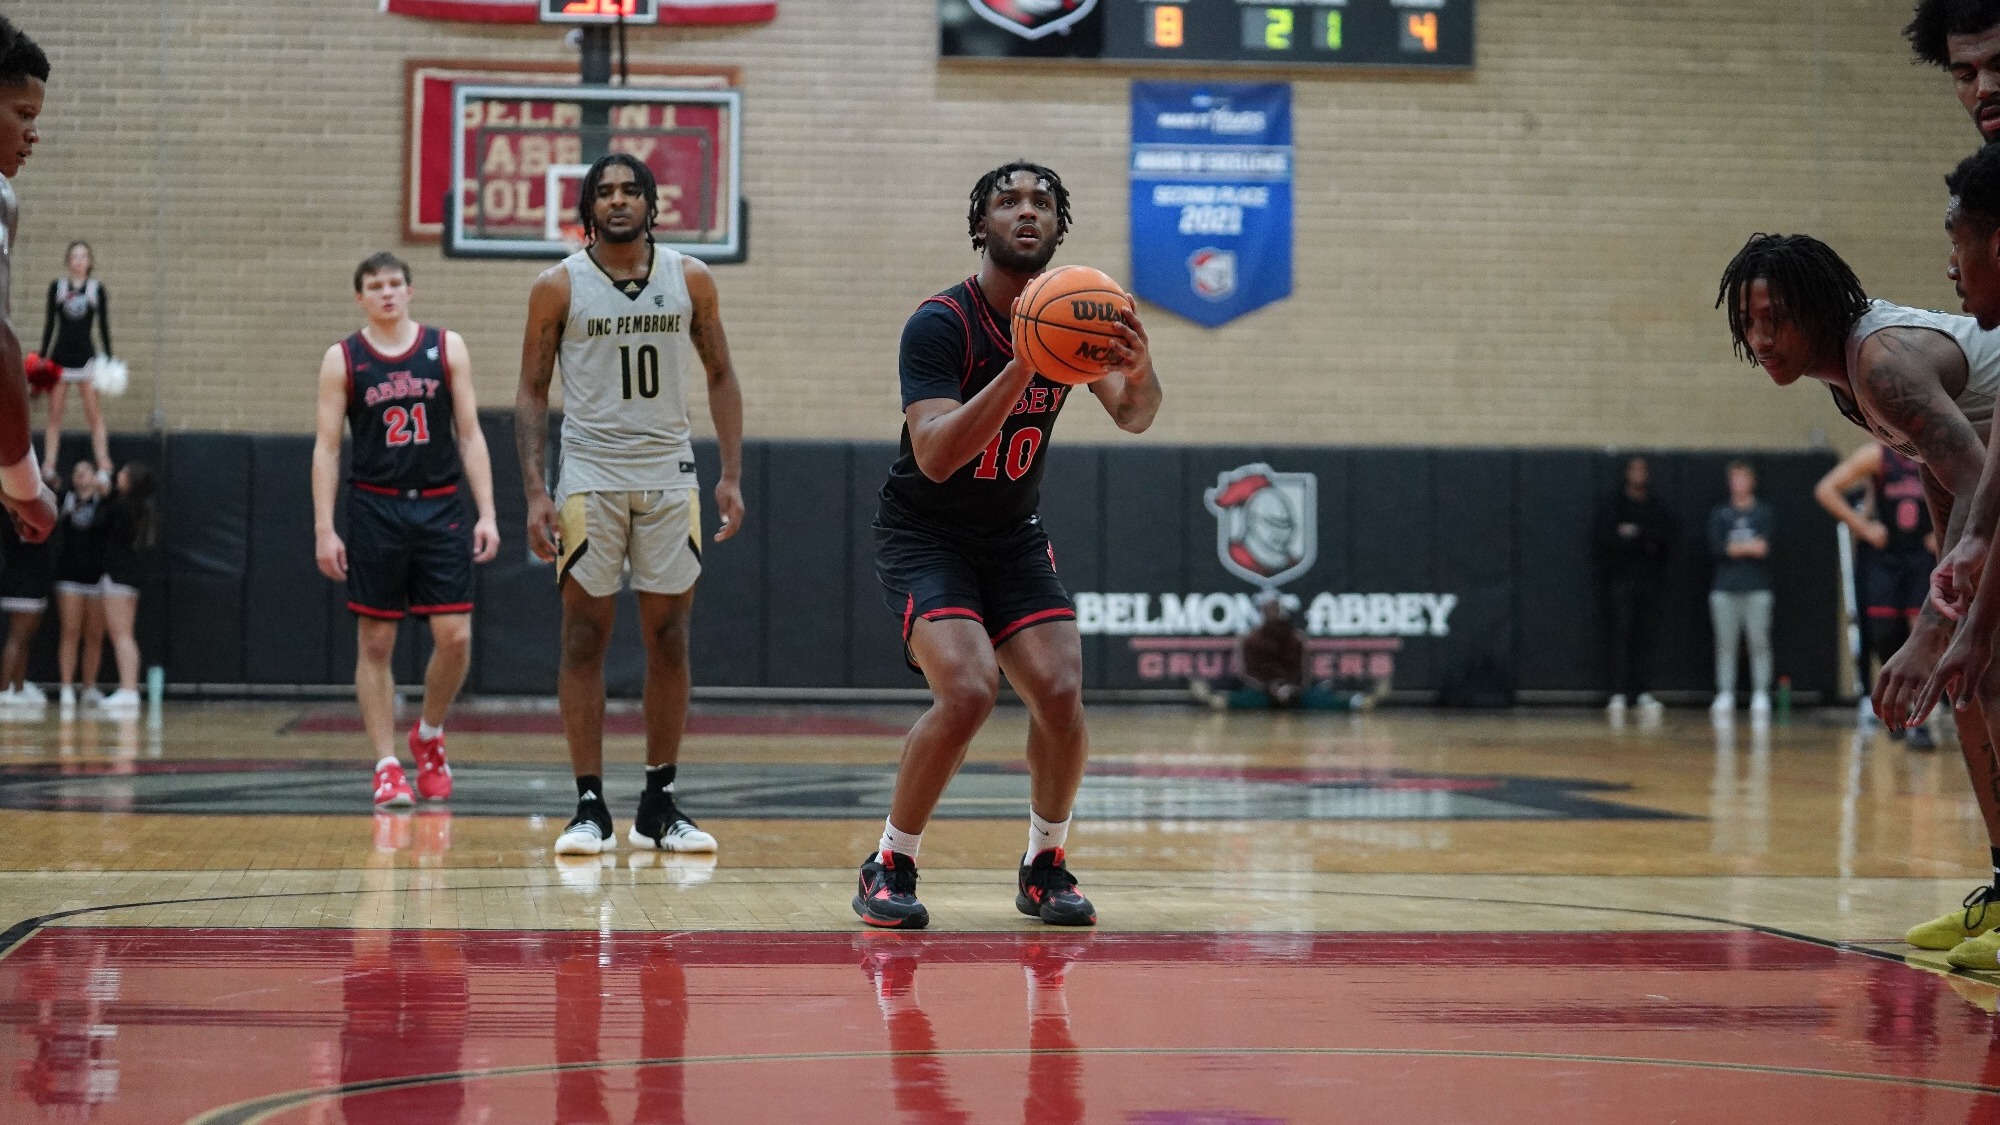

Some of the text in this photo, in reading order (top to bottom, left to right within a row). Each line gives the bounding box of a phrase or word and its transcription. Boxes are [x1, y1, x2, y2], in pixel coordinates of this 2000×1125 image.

[1154, 6, 1183, 47] 8
[1265, 8, 1342, 49] 2 1
[1408, 12, 1437, 51] 4
[464, 101, 676, 129] ELMNT
[484, 135, 656, 175] ABBY
[464, 178, 683, 226] COLLE
[1179, 205, 1242, 235] 2021
[587, 314, 681, 336] UNC PEMBROKE
[365, 377, 440, 406] ABBEY
[619, 344, 660, 400] 10
[383, 402, 430, 447] 21
[974, 427, 1042, 481] 10
[1075, 592, 1457, 635] BELMON ABBEY
[1138, 652, 1394, 678] CRUERS
